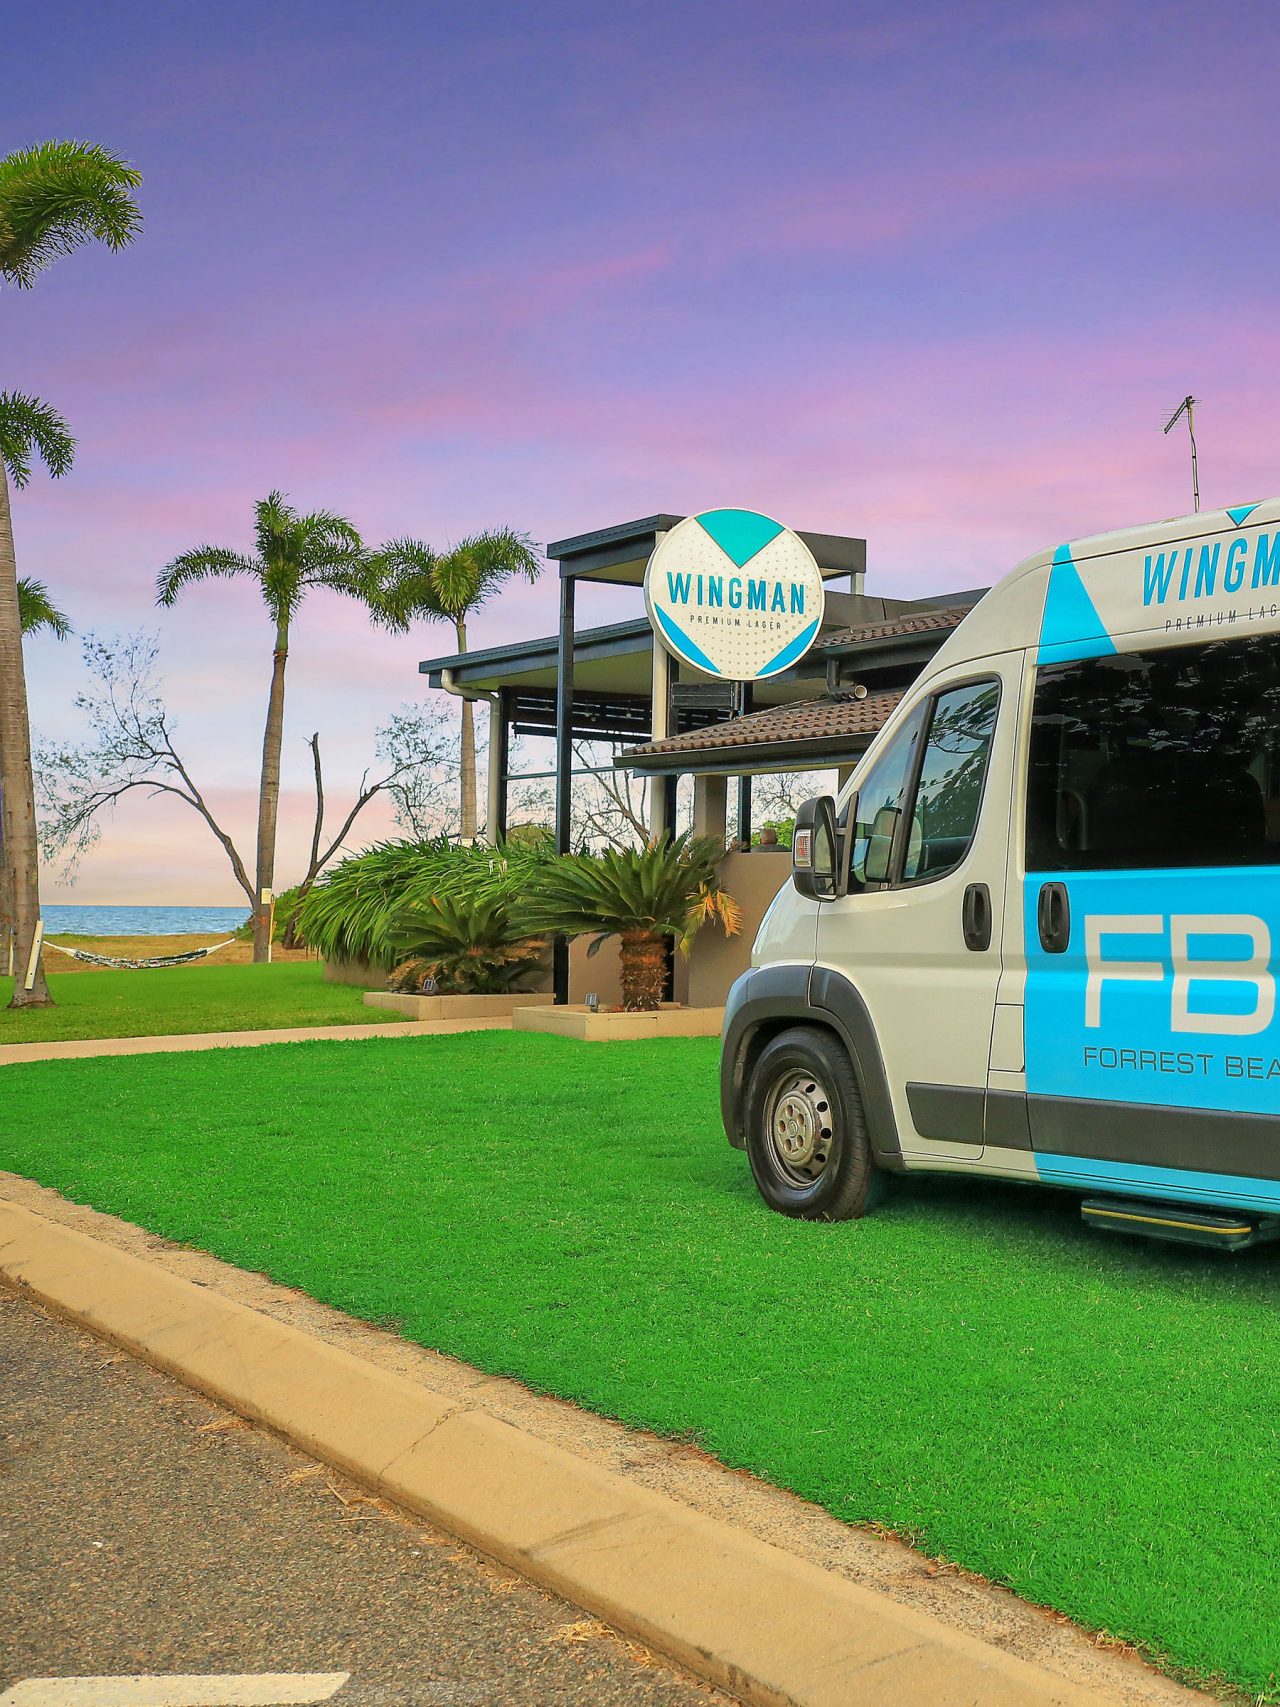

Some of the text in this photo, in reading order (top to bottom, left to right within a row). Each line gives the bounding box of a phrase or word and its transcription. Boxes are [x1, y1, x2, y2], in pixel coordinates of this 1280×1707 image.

[666, 571, 805, 615] WINGMAN
[690, 614, 782, 630] PREMIUM LAGER
[1165, 609, 1236, 632] PREMIUM
[1084, 1046, 1214, 1076] FORREST
